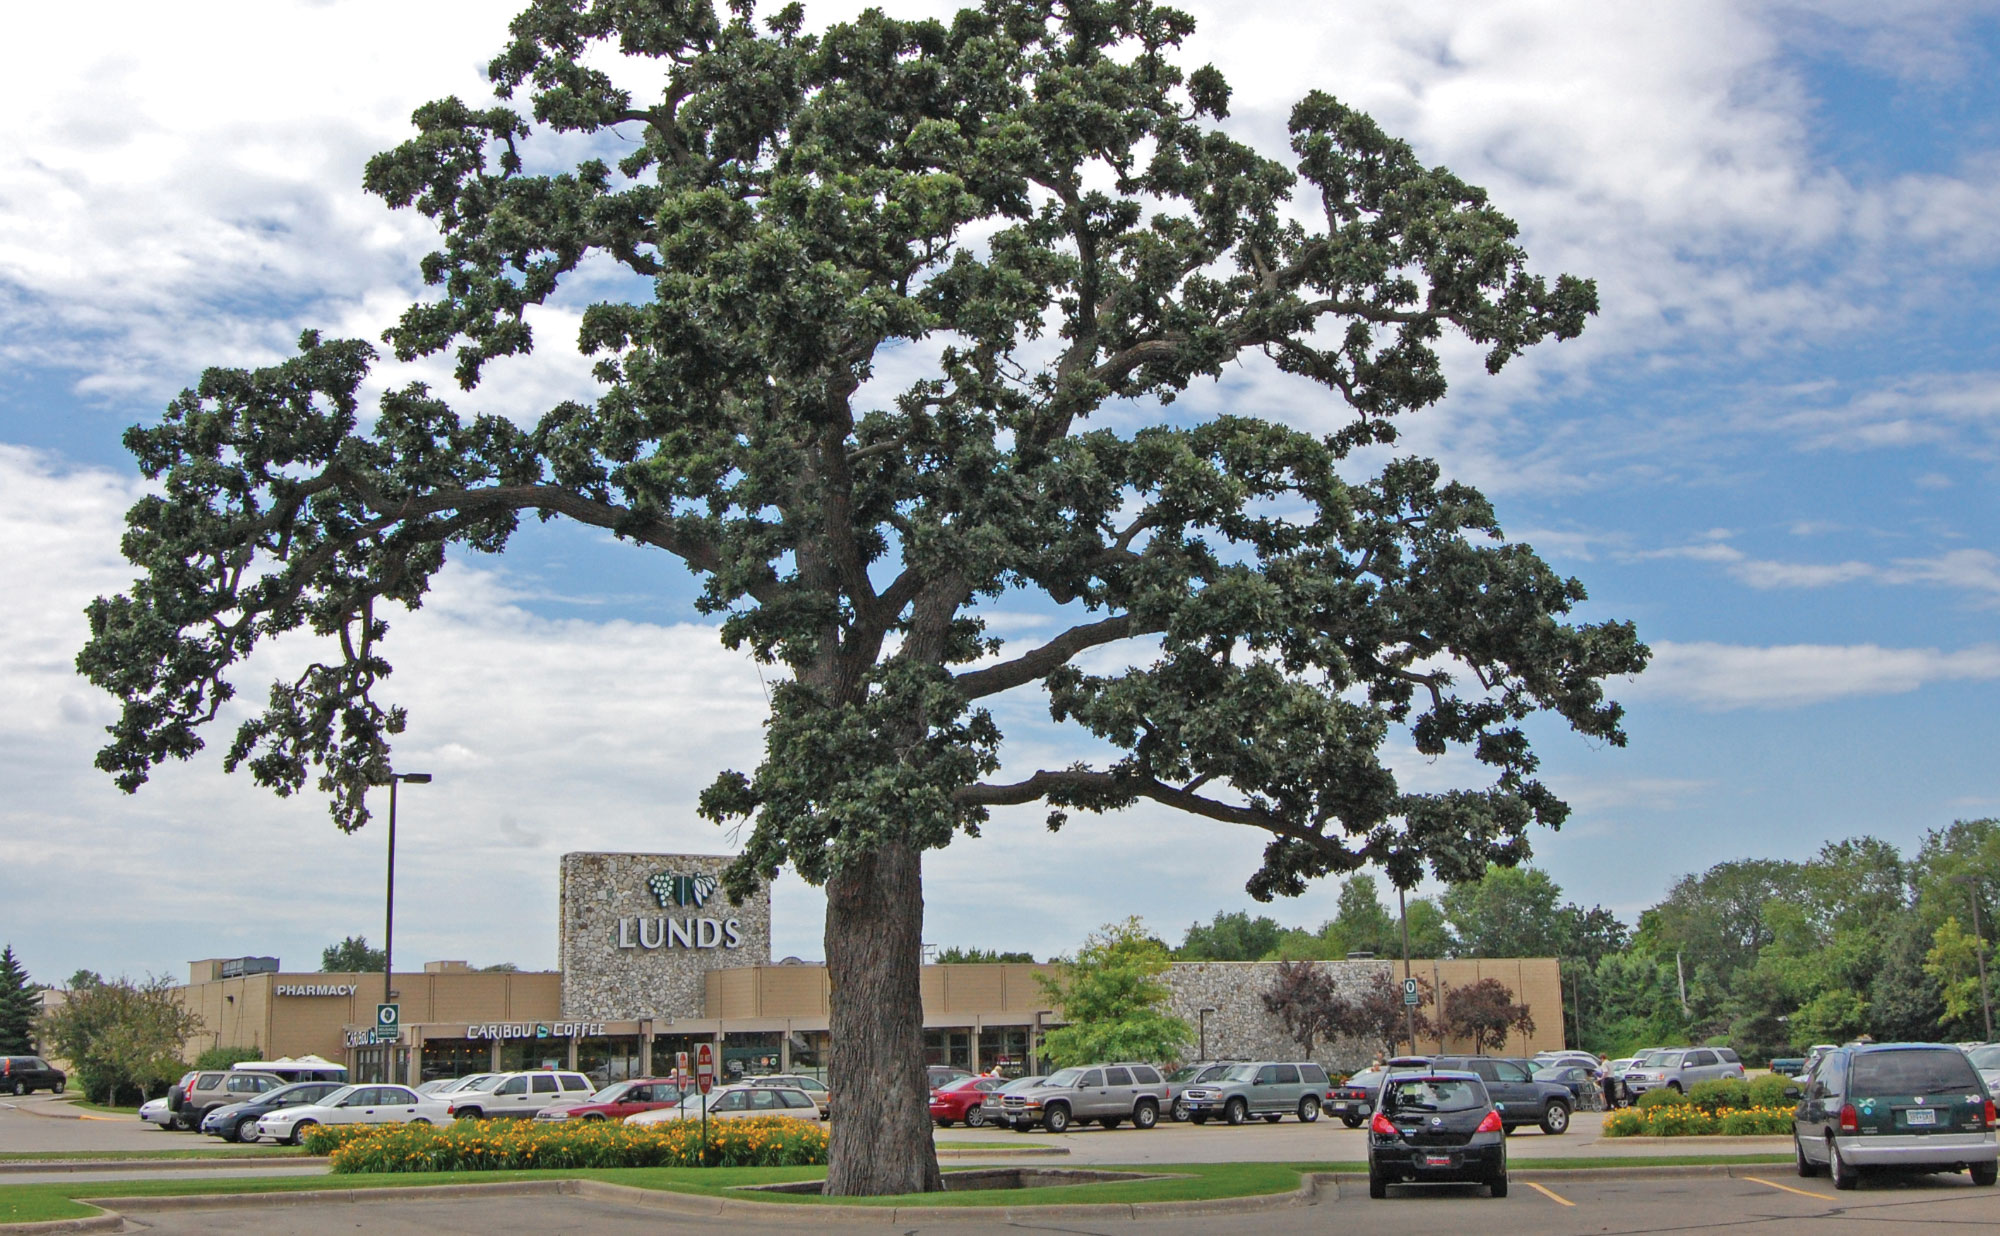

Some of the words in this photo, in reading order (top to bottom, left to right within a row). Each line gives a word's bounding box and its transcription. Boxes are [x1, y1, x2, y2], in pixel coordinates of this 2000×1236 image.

[618, 917, 741, 949] LUNDS
[277, 985, 357, 996] PHARMACY
[467, 1023, 532, 1039] CARIBOU
[552, 1022, 606, 1037] COFFEE
